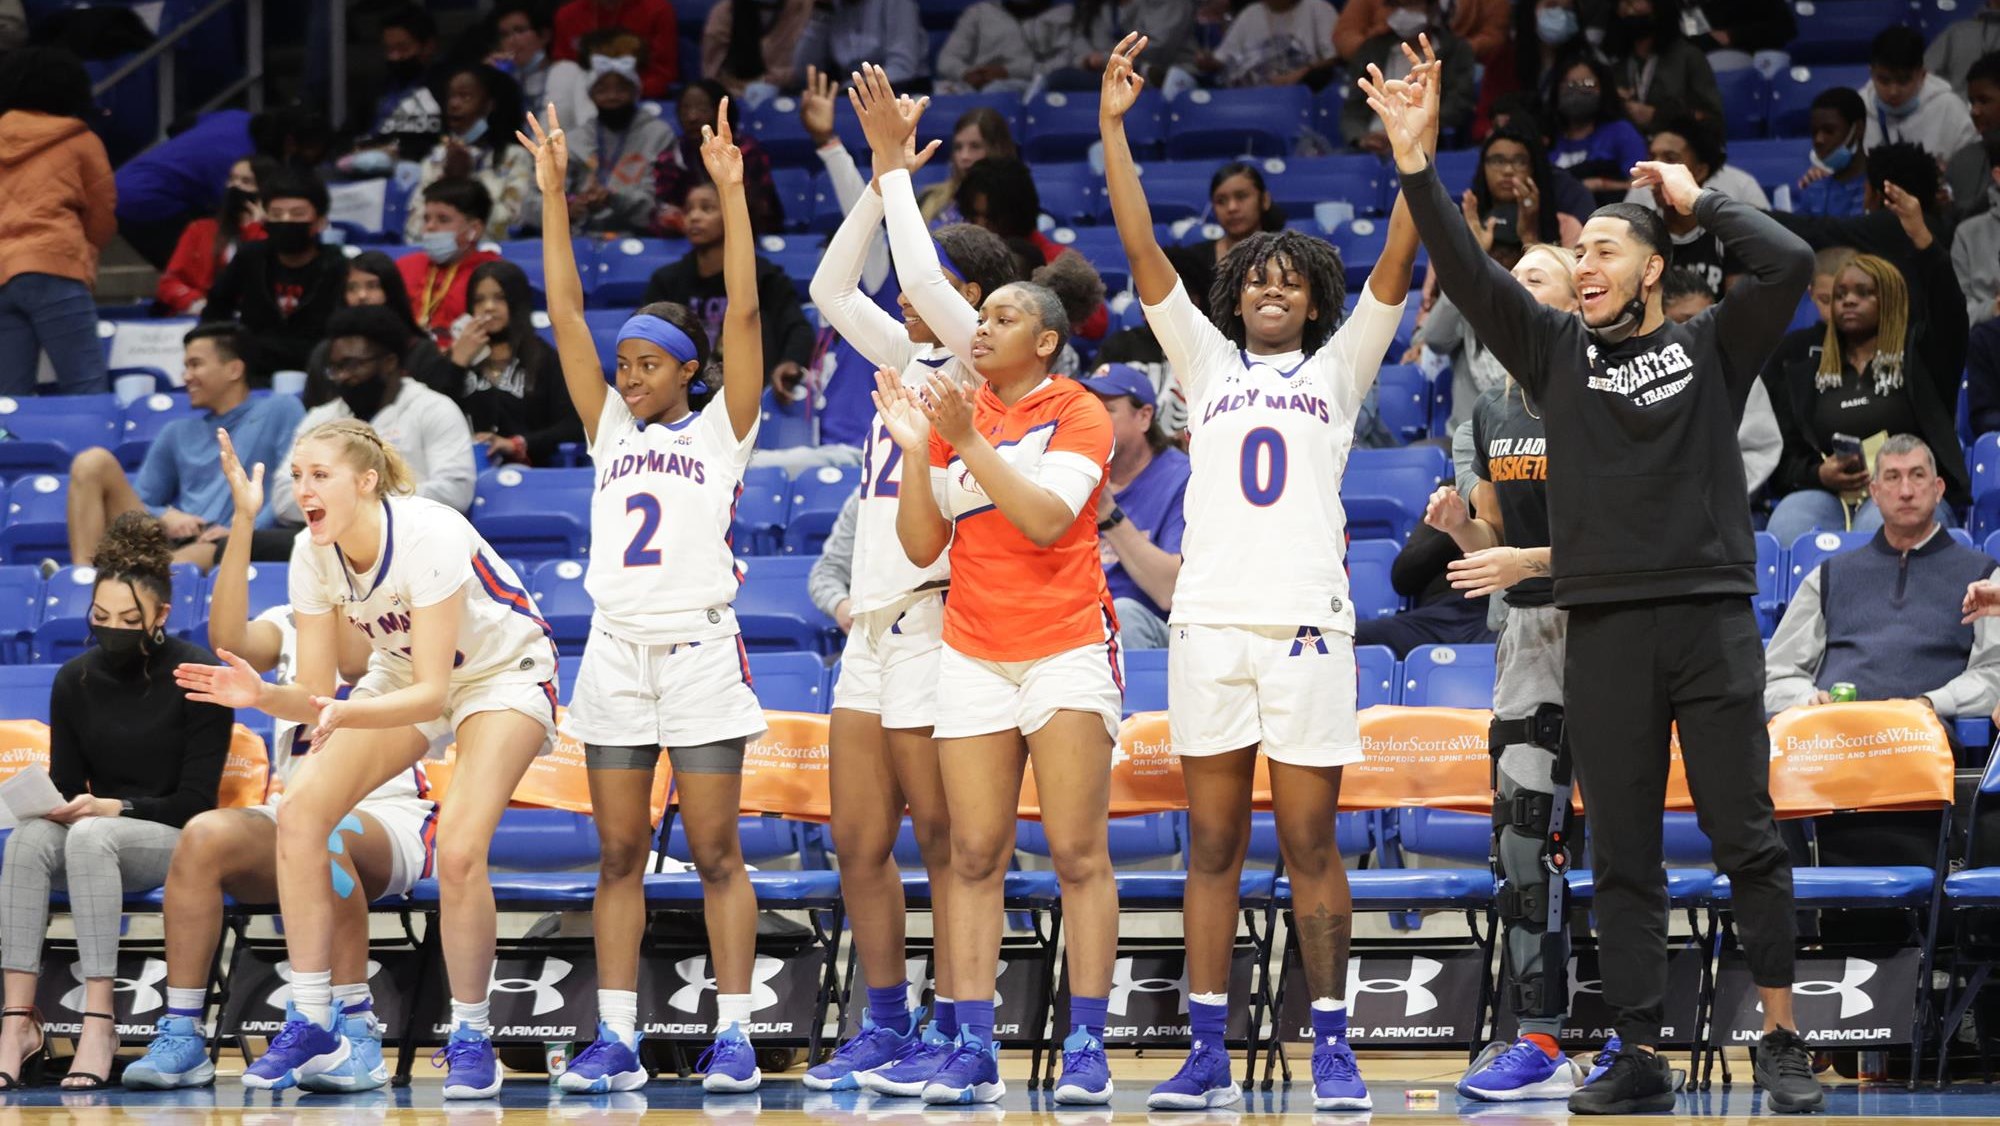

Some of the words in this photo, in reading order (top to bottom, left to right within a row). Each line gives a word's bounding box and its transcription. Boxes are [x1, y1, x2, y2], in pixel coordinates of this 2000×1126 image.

[1202, 388, 1260, 425] LADY
[1265, 393, 1330, 424] MAVS
[1489, 438, 1513, 458] UTA
[1239, 426, 1288, 508] 0
[623, 491, 662, 568] 2
[1847, 751, 1865, 759] AND
[1868, 748, 1892, 757] SPINE
[498, 1025, 577, 1037] ARMOUR
[643, 1022, 708, 1034] UNDER
[1369, 1026, 1455, 1038] ARMOUR
[1804, 1027, 1892, 1041] ARMOUR
